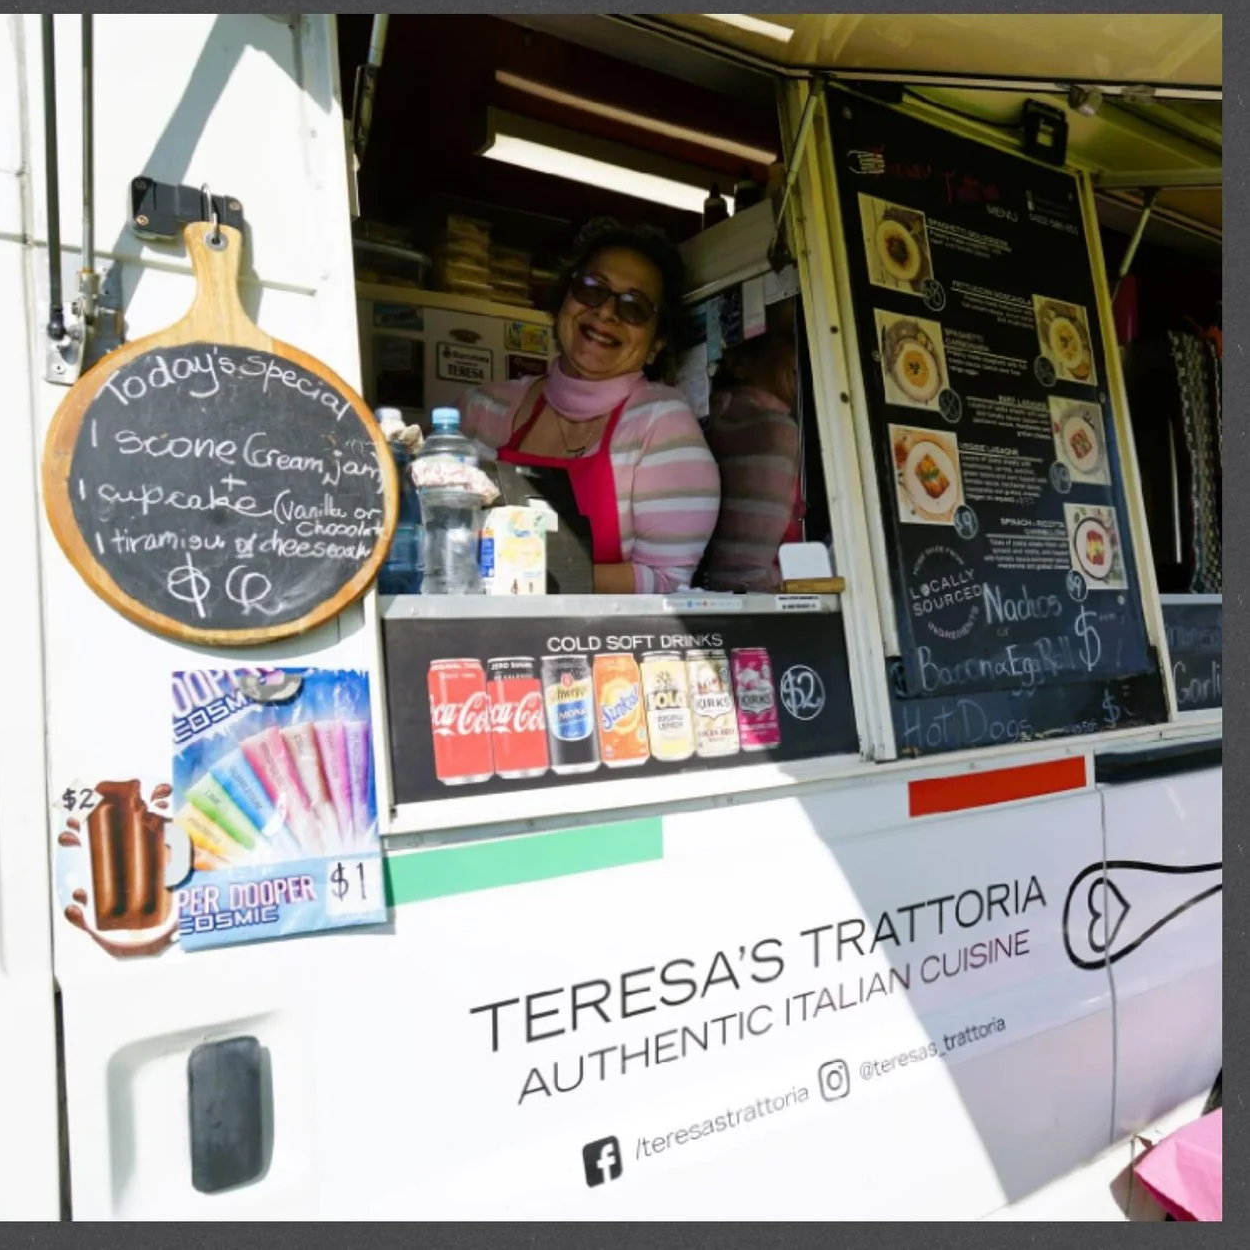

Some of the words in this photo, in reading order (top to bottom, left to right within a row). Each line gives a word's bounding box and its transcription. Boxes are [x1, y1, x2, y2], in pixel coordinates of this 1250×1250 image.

[94, 346, 237, 406] Today's
[239, 355, 352, 422] Special
[446, 364, 485, 380] TERESA
[1000, 517, 1032, 527] SPINACH
[908, 567, 976, 600] LOCALLY
[912, 583, 983, 618] SOURCED
[982, 582, 1062, 626] Nachos
[547, 634, 602, 652] COLD
[606, 634, 655, 651] SOFT
[660, 632, 724, 649] DRINKS
[696, 697, 733, 711] KIRKS
[781, 669, 822, 716] $2
[172, 691, 250, 744] COSM
[902, 704, 954, 749] Hot
[958, 699, 1034, 745] Dogs
[61, 787, 96, 811] $2
[229, 875, 318, 908] DOOPER
[330, 861, 369, 902] $1
[469, 936, 786, 1053] TERESA'S
[799, 874, 1048, 968] TRATTORIA
[517, 1003, 775, 1105] AUTHENTIC
[784, 964, 912, 1027] ITALIAN
[919, 928, 1032, 986] CUISINE
[858, 1013, 1007, 1083] @teresas_trattoria
